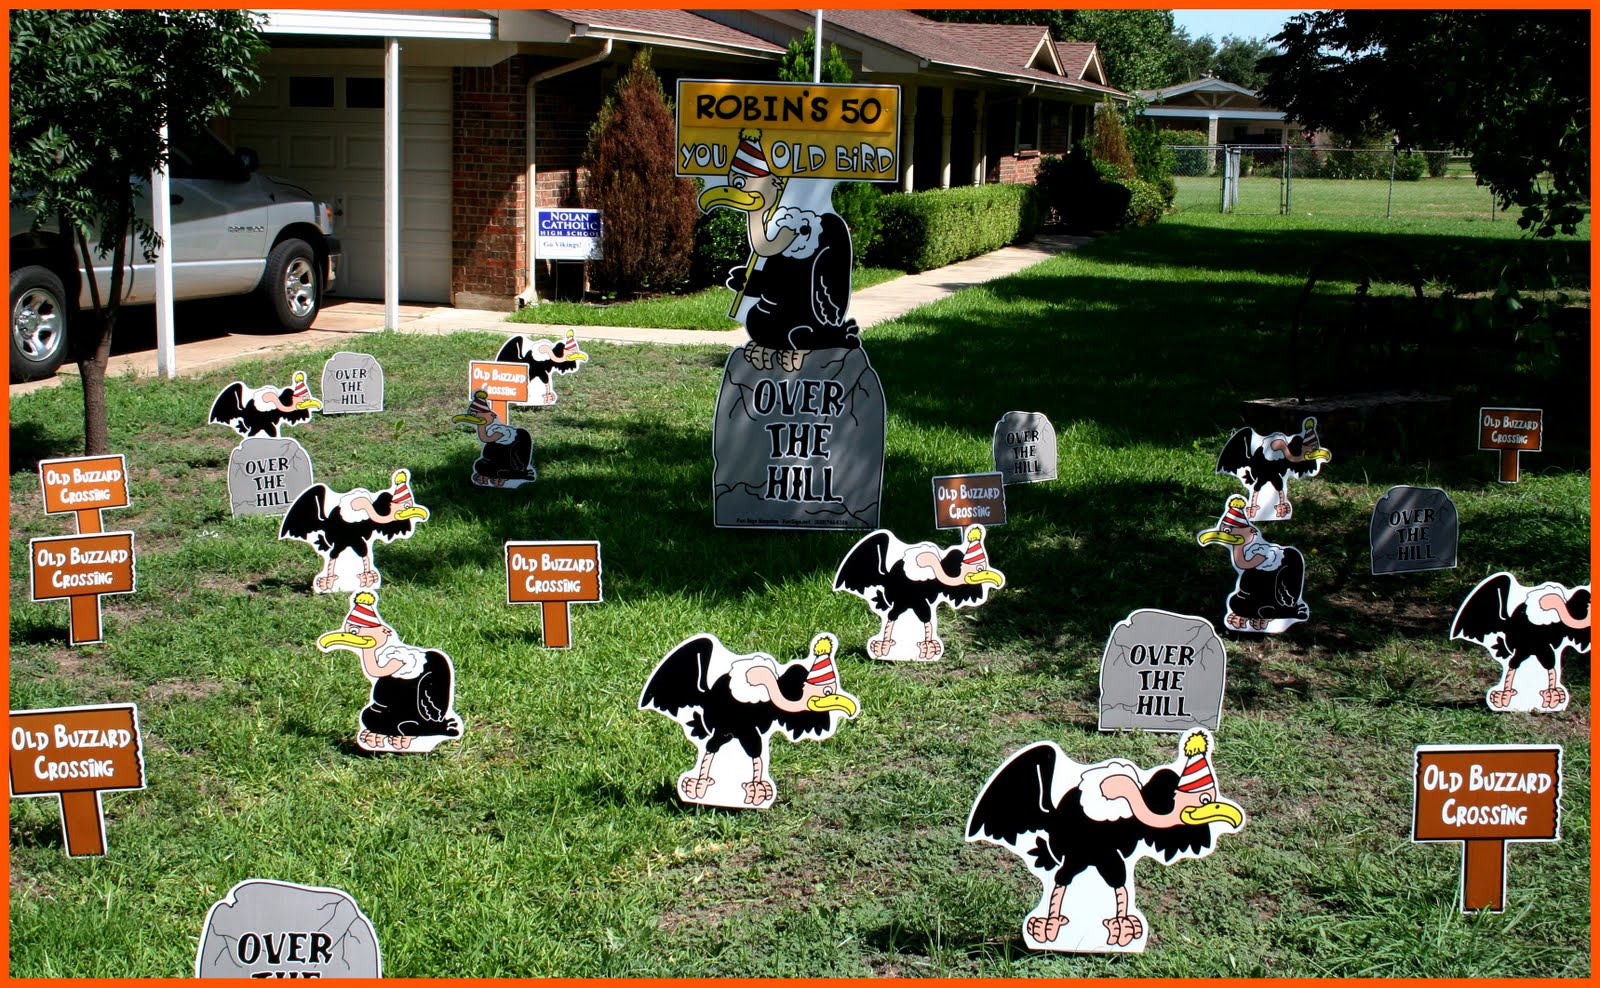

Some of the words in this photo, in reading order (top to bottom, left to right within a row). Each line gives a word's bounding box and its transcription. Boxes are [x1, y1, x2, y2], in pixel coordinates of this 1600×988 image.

[697, 90, 828, 122] ROBIN'S
[841, 98, 881, 124] 50
[681, 143, 727, 169] YOU
[771, 141, 826, 174] OLD
[542, 220, 598, 230] CATHOLIC
[550, 212, 589, 221] NOLAN
[336, 368, 367, 380] OVER
[341, 381, 363, 392] THE
[341, 394, 368, 404] HILL
[753, 379, 845, 417] OVER
[1484, 415, 1500, 428] OLD
[1503, 416, 1538, 430] BUZZARD
[765, 423, 832, 459] THE
[1006, 430, 1040, 445] OVER
[1013, 445, 1036, 459] THE
[245, 457, 289, 474] OVER
[1014, 460, 1041, 474] HILL
[47, 470, 70, 485] OLD
[73, 468, 121, 483] BUZZARD
[253, 474, 285, 490] THE
[765, 466, 843, 503] HILL
[257, 491, 293, 506] HILL
[938, 486, 957, 501] OLD
[960, 484, 1000, 500] BUZZARD
[1390, 508, 1435, 525] OVER
[1397, 527, 1430, 543] THE
[37, 549, 66, 567] OLD
[70, 547, 128, 565] BUZZARD
[1397, 545, 1436, 560] HILL
[512, 553, 538, 572] OLD
[541, 553, 595, 572] BUZZARD
[1130, 644, 1195, 666] OVER
[1138, 670, 1185, 691] THE
[1136, 695, 1191, 716] HILL
[11, 726, 49, 751] OLD
[54, 723, 131, 748] BUZZARD
[1423, 764, 1463, 793] OLD
[1469, 764, 1551, 794] BUZZARD
[238, 932, 333, 964] OVER
